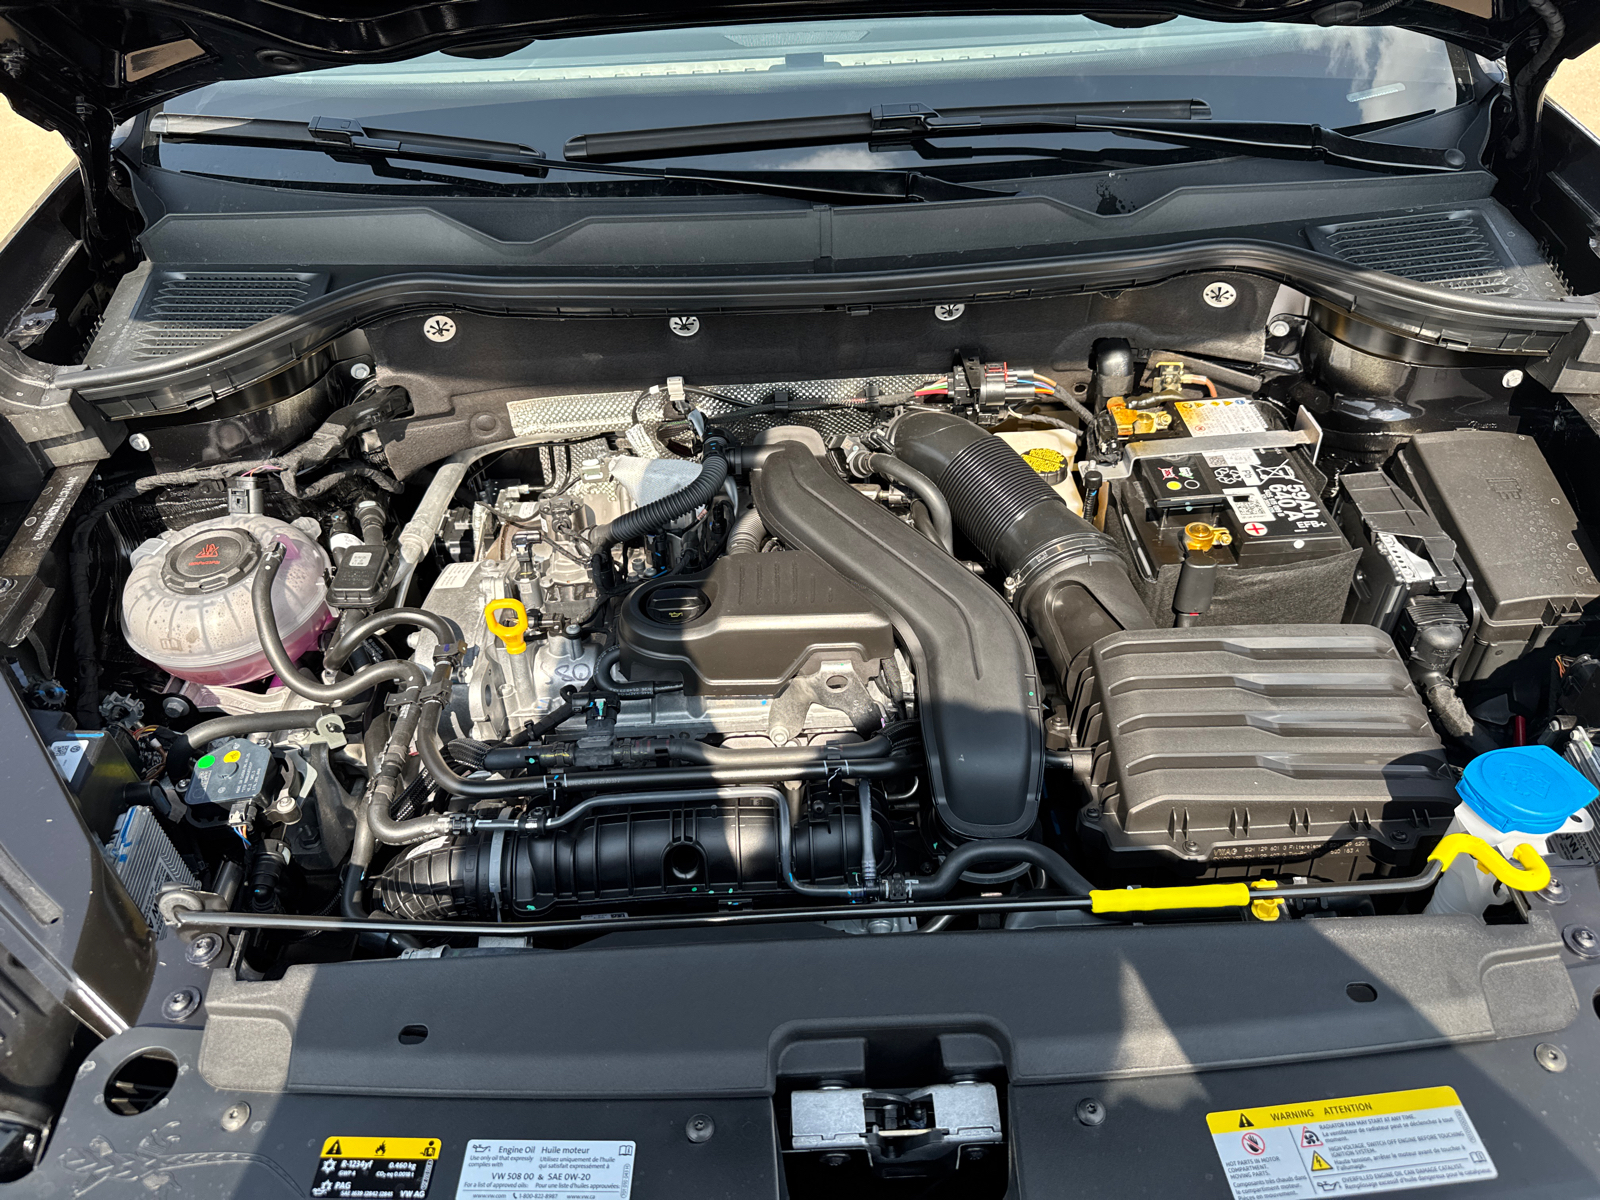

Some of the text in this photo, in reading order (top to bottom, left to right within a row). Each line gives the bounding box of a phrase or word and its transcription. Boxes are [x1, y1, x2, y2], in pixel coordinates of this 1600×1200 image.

[1269, 484, 1297, 507] 640
[1287, 485, 1321, 518] 59Ah
[1270, 1102, 1373, 1121] WARNING ATTENTION
[1319, 1122, 1345, 1130] RADIATOR
[1366, 1140, 1386, 1148] SWITCH
[1438, 1131, 1465, 1139] TOUCHING
[498, 1146, 536, 1155] Engine Oil
[541, 1146, 561, 1154] Huile
[340, 1160, 374, 1171] R-1234yf
[408, 1162, 417, 1172] kg
[492, 1172, 506, 1180] VW
[548, 1173, 563, 1181] SAE
[564, 1173, 591, 1181] 0W-20
[1230, 1172, 1252, 1180] MOVING
[1342, 1174, 1374, 1183] OVERFILLED
[1374, 1171, 1394, 1179] ENGINE
[334, 1181, 352, 1190] PAG
[493, 1182, 518, 1190] approved
[1233, 1180, 1265, 1188] Composants
[400, 1190, 426, 1198] VW AG
[1242, 1185, 1280, 1194] compartiment
